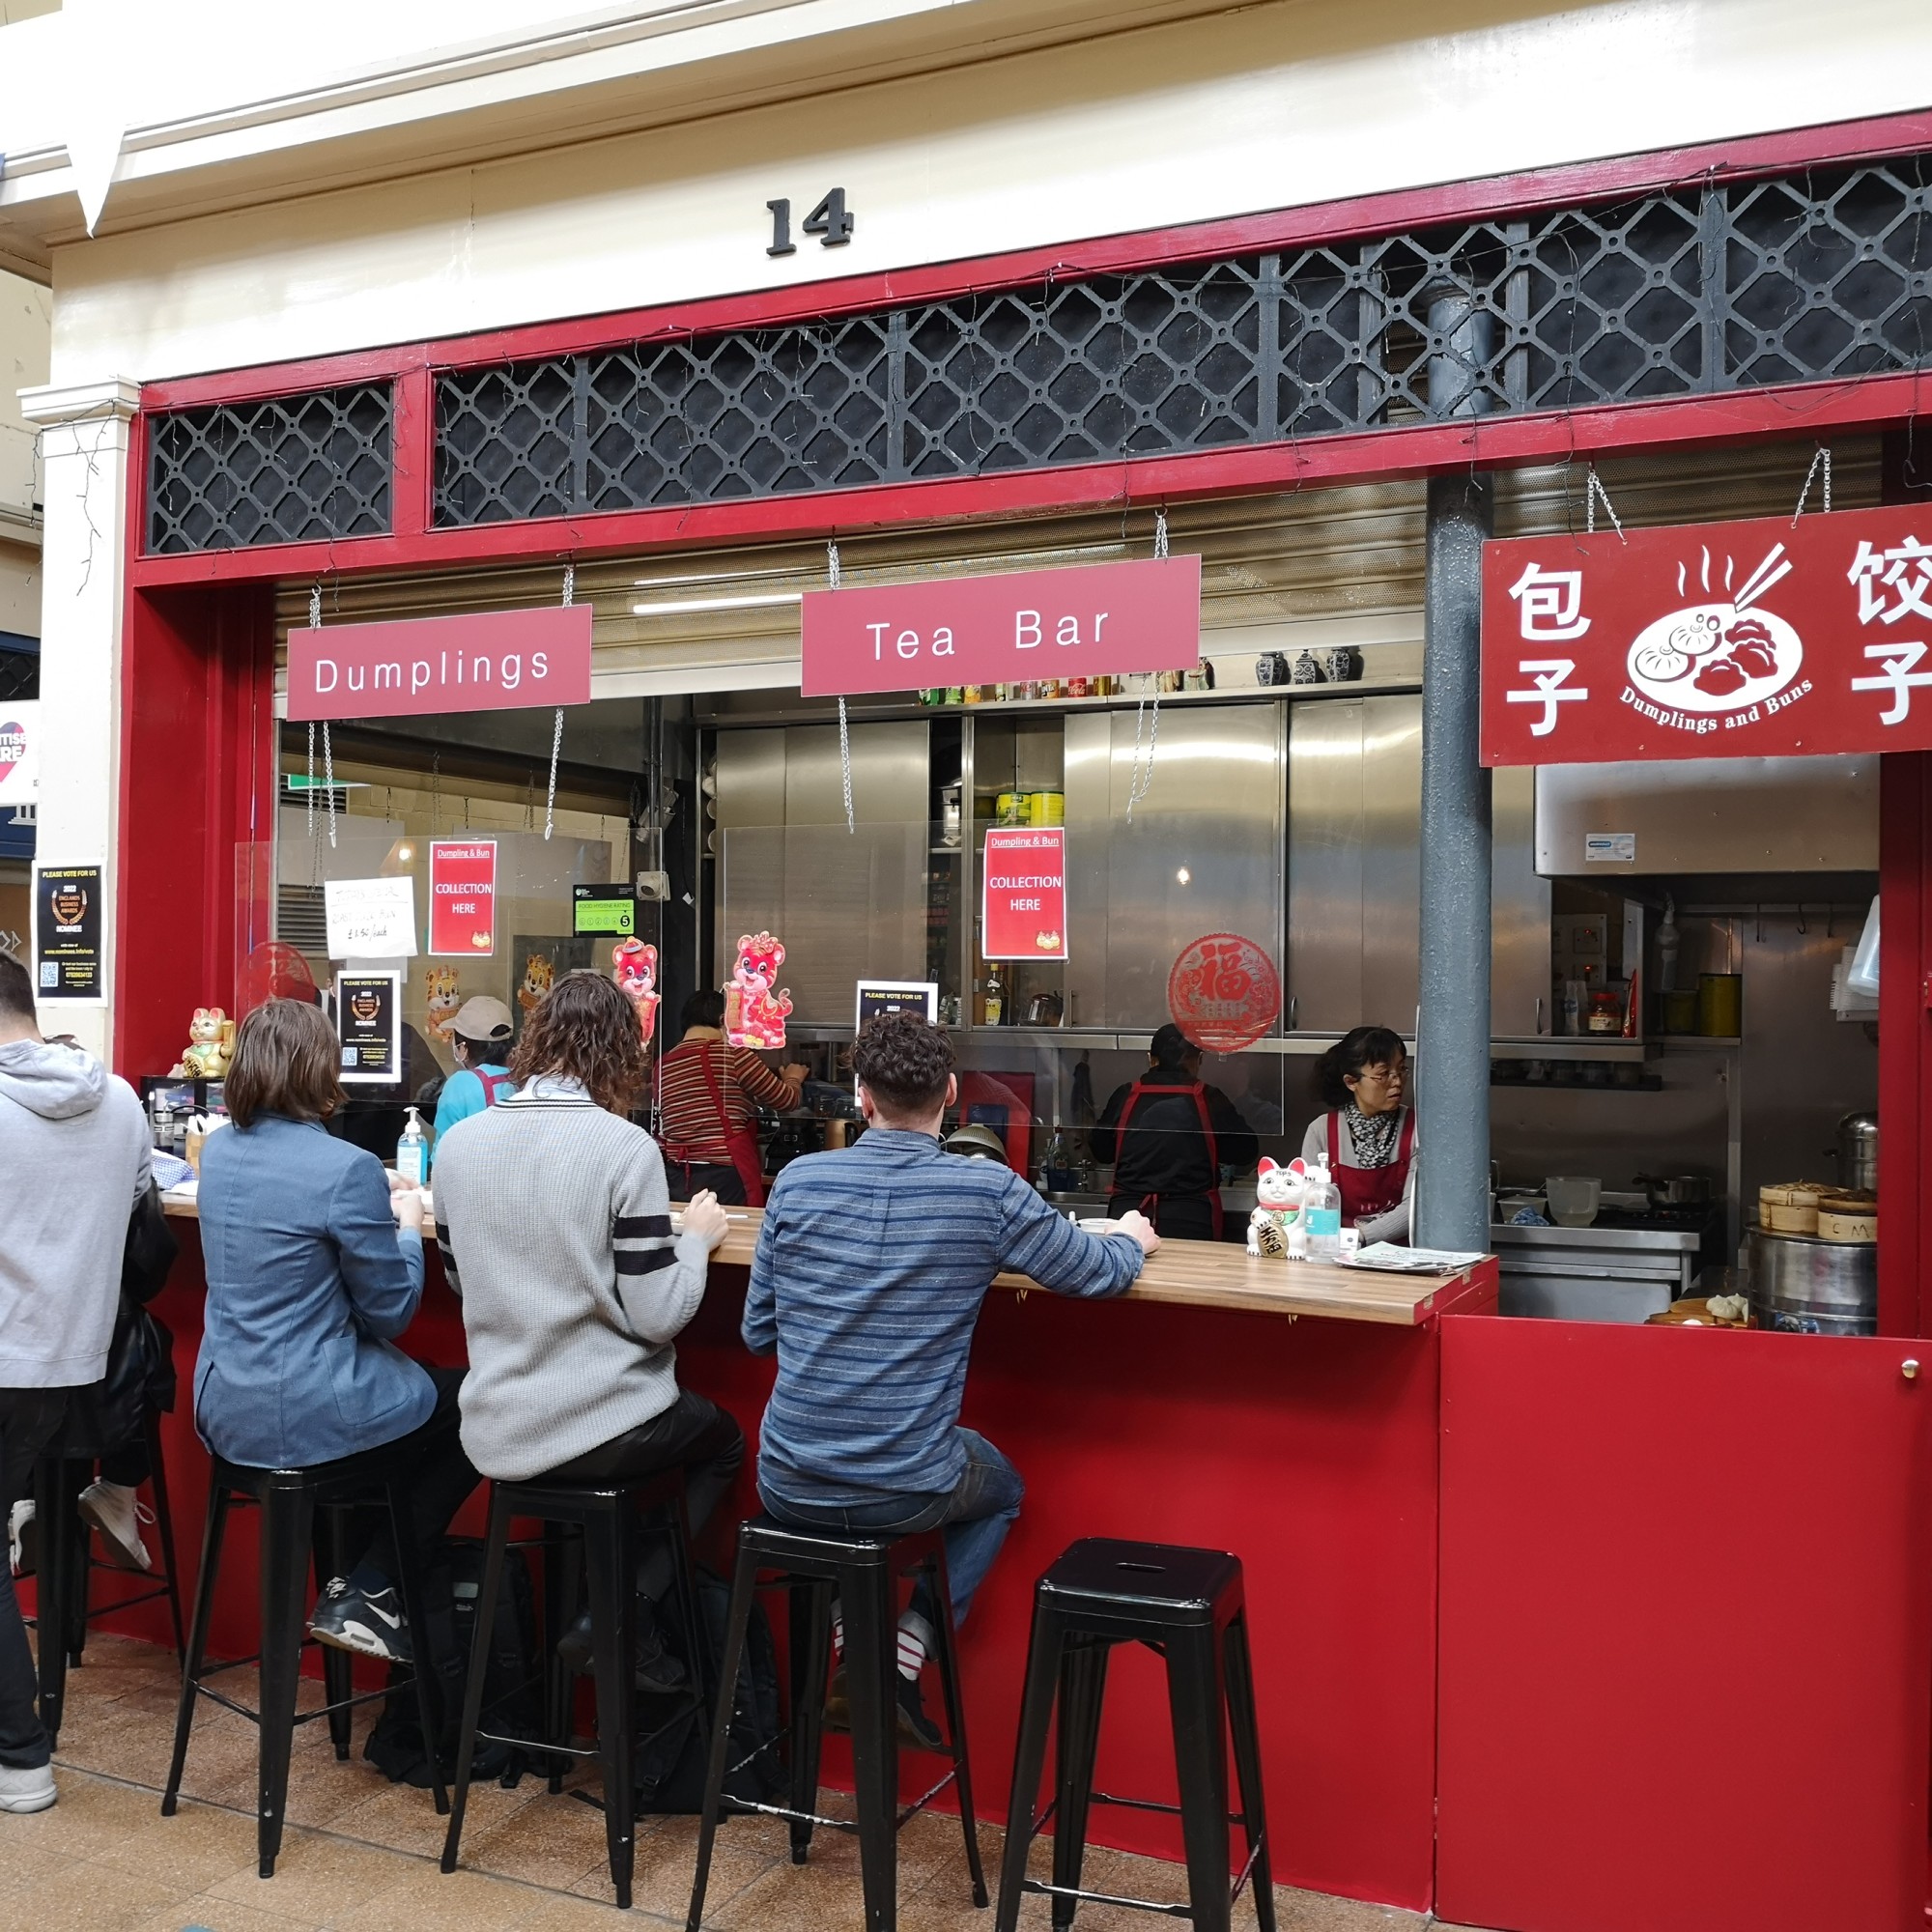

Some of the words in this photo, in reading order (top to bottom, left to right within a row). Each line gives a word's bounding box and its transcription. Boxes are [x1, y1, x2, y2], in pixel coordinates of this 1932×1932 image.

[766, 187, 854, 256] 14
[866, 622, 955, 661] Tea
[1015, 610, 1109, 649] Bar
[1506, 562, 1592, 737] 包子
[315, 650, 549, 695] Dumplings
[1619, 686, 1718, 734] Dumplings
[1725, 706, 1761, 728] and
[1764, 679, 1813, 715] Buns
[991, 838, 1031, 847] Dumpling
[1033, 837, 1039, 845] &
[1042, 837, 1059, 845] Bun
[437, 849, 469, 858] Dumpling
[436, 883, 492, 894] COLLECTION
[989, 876, 1062, 889] COLLECTION
[452, 903, 476, 914] HERE
[1010, 899, 1040, 911] HERE
[621, 916, 629, 926] 5
